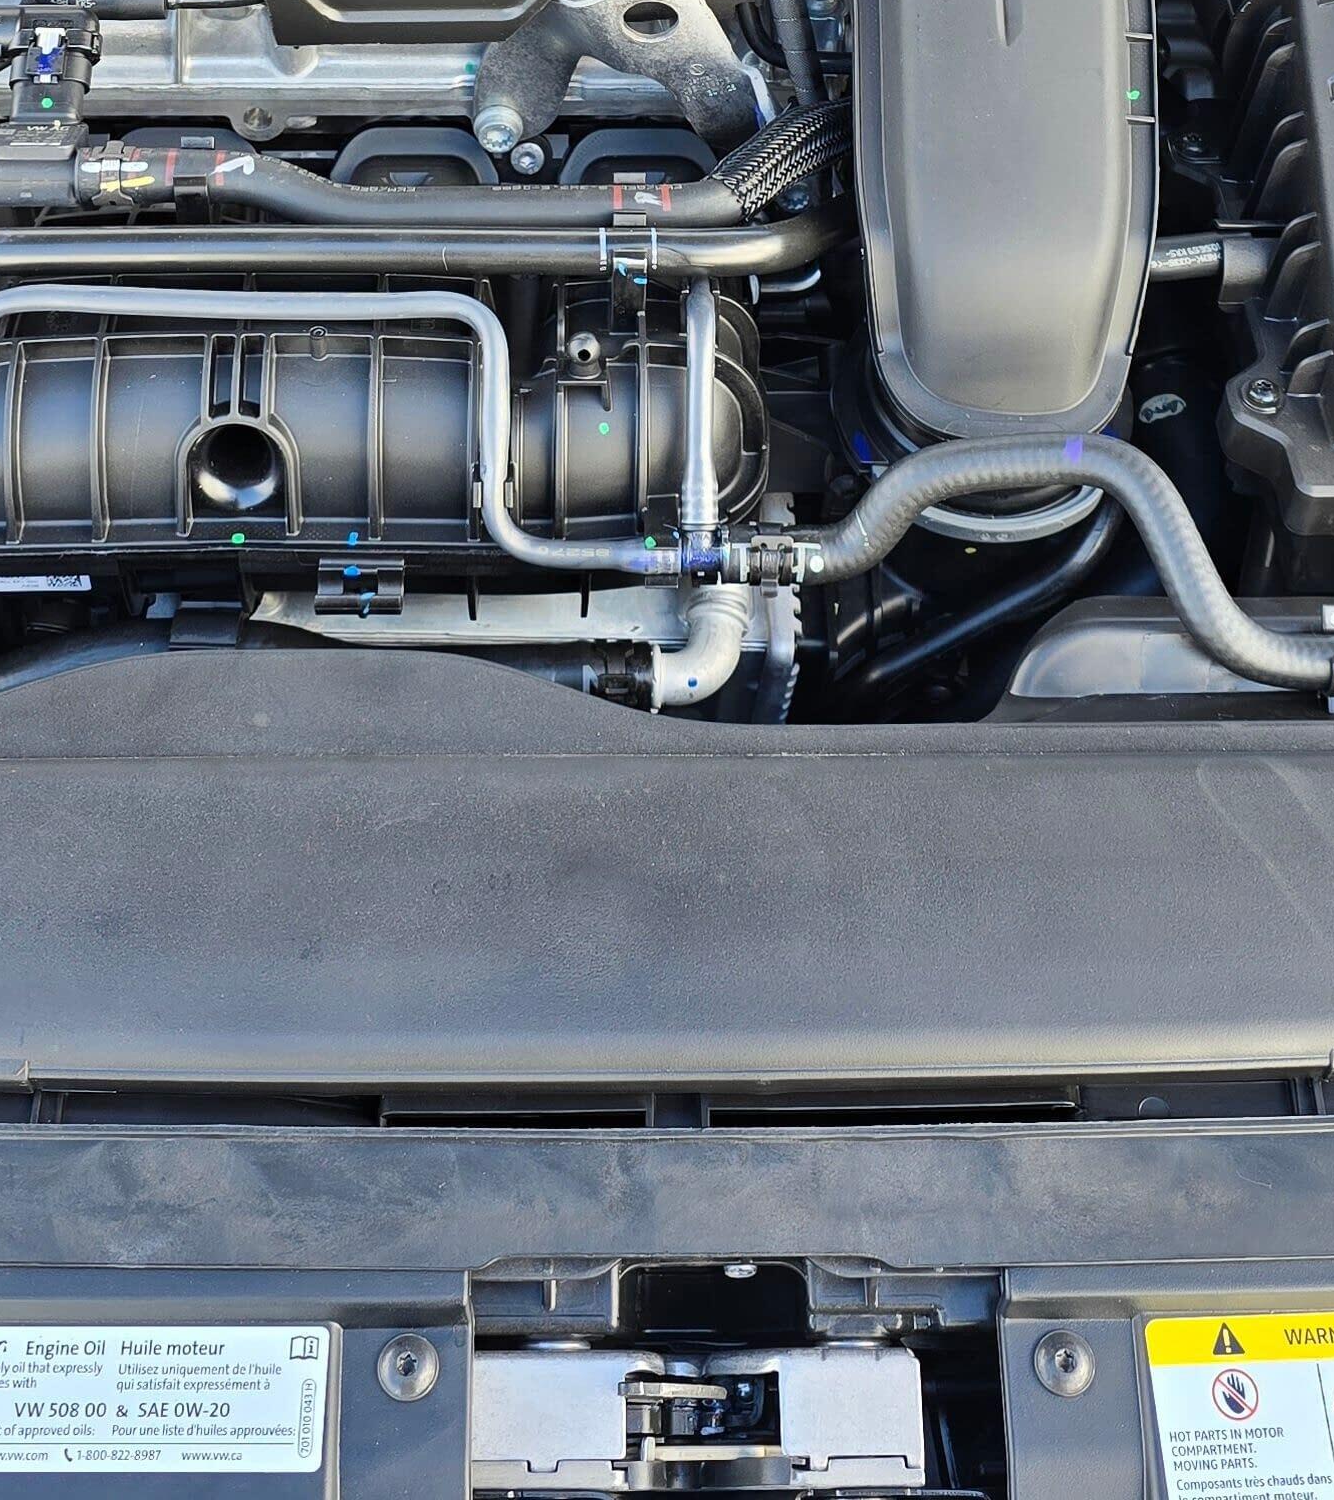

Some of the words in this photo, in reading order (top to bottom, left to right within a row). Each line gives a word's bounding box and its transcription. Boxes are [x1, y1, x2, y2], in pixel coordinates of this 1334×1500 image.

[26, 1340, 79, 1360] Engine
[84, 1340, 106, 1355] Oil
[121, 1340, 162, 1356] Huile
[167, 1342, 225, 1356] moteur
[12, 1362, 25, 1373] oil
[28, 1362, 50, 1373] that
[53, 1362, 103, 1377] expressly
[118, 1364, 159, 1375] Utilisez
[162, 1364, 230, 1378] uniquement
[232, 1364, 246, 1375] de
[249, 1364, 282, 1375] l'huile
[13, 1377, 37, 1389] with
[116, 1379, 134, 1393] qui
[137, 1379, 180, 1390] satisfait
[183, 1379, 260, 1393] expressément
[264, 1379, 270, 1390] à
[15, 1402, 45, 1417] VW
[49, 1402, 79, 1417] 508
[85, 1402, 107, 1417] 00
[116, 1404, 128, 1418] &
[138, 1403, 169, 1418] SAE
[174, 1403, 231, 1418] 0W-20
[303, 1394, 312, 1411] 043
[4, 1424, 18, 1436] of
[18, 1424, 70, 1439] approved
[72, 1424, 95, 1436] oils:
[112, 1425, 137, 1436] Pour
[140, 1427, 159, 1436] une
[162, 1425, 185, 1436] liste
[187, 1424, 228, 1436] d'huiles
[230, 1424, 296, 1439] approuvées:
[301, 1416, 311, 1433] 010
[1169, 1431, 1190, 1442] HOT
[1195, 1429, 1227, 1441] PARTS
[1231, 1429, 1242, 1440] IN
[1245, 1427, 1284, 1439] MOTOR
[301, 1435, 310, 1453] 701
[1171, 1443, 1257, 1457] COMPARTMENT.
[77, 1450, 161, 1461] 1-800-822-8987
[181, 1452, 243, 1461] www.vw.ca
[1173, 1459, 1218, 1472] MOVING
[1221, 1457, 1257, 1469] PARTS.
[1176, 1478, 1242, 1492] Composants
[1245, 1476, 1265, 1487] très
[1267, 1474, 1305, 1486] chauds
[1307, 1473, 1332, 1485] dans
